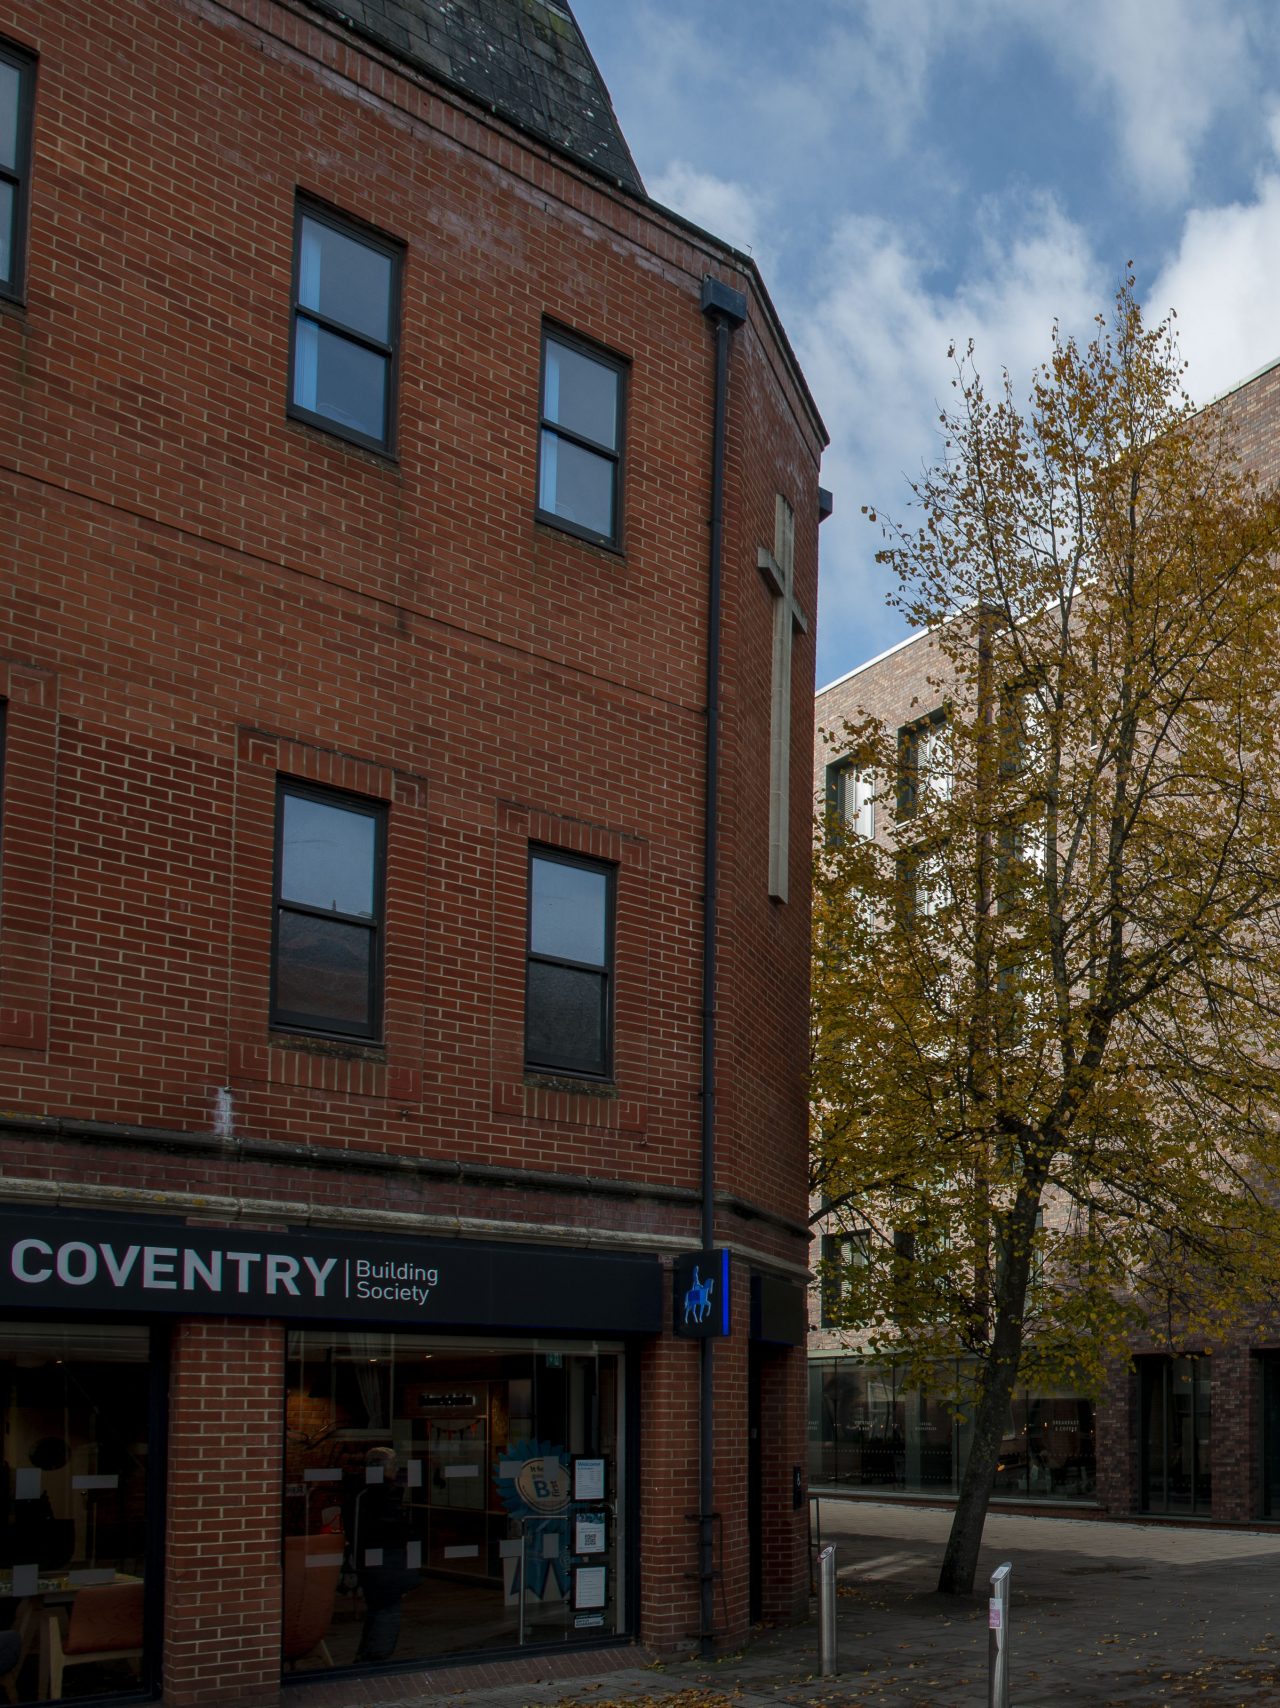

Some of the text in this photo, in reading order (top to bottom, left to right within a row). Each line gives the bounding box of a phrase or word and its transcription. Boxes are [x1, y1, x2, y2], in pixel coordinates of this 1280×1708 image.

[10, 1238, 338, 1297] COVENTRY
[356, 1259, 438, 1286] Building
[356, 1280, 429, 1306] Society
